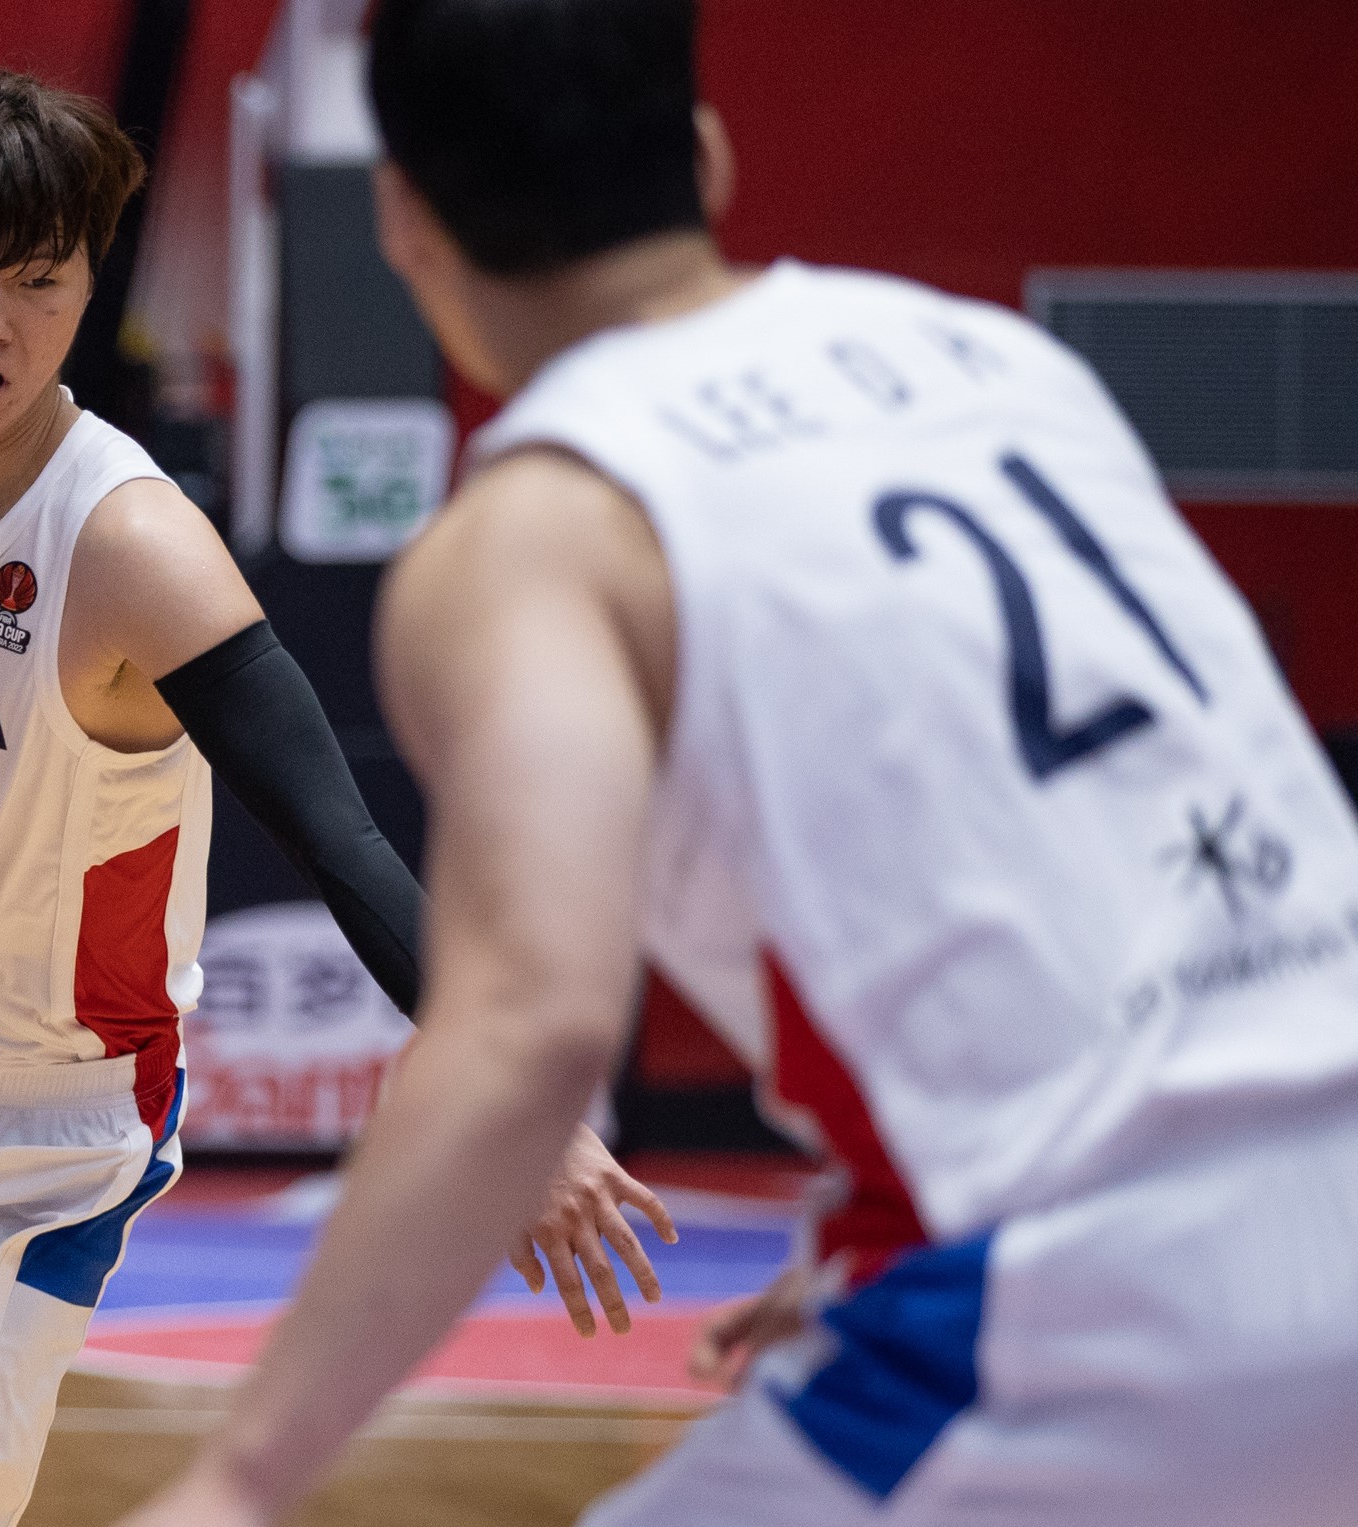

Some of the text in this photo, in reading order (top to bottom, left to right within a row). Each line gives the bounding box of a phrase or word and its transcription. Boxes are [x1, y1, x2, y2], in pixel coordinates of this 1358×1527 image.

[867, 446, 1216, 786] 21
[4, 625, 26, 643] CUP
[7, 641, 24, 653] 2022
